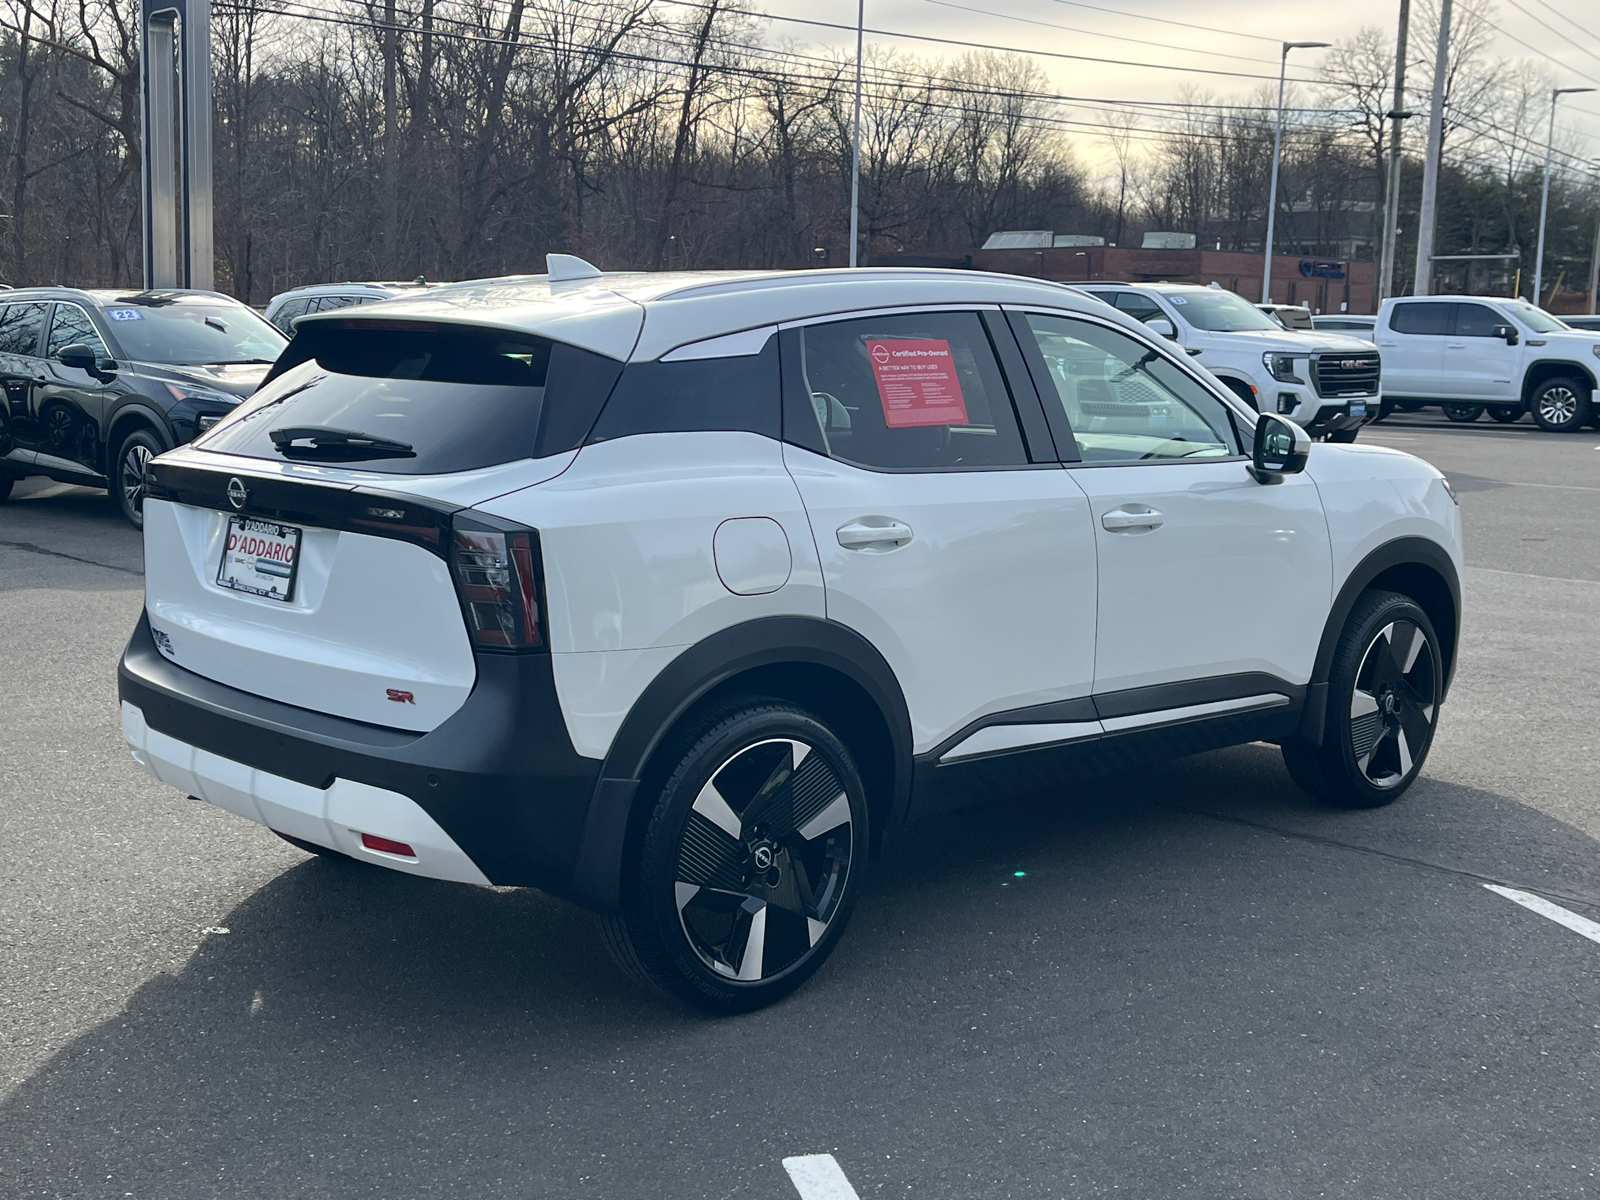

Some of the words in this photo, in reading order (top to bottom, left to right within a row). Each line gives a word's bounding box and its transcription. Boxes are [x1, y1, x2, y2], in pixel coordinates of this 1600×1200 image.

[116, 310, 135, 319] 22
[917, 349, 948, 357] Pre-Owned
[1341, 360, 1369, 369] GMC
[245, 520, 279, 535] D'ADDARIO
[226, 533, 295, 563] D'ADDARIO
[386, 688, 416, 705] SR
